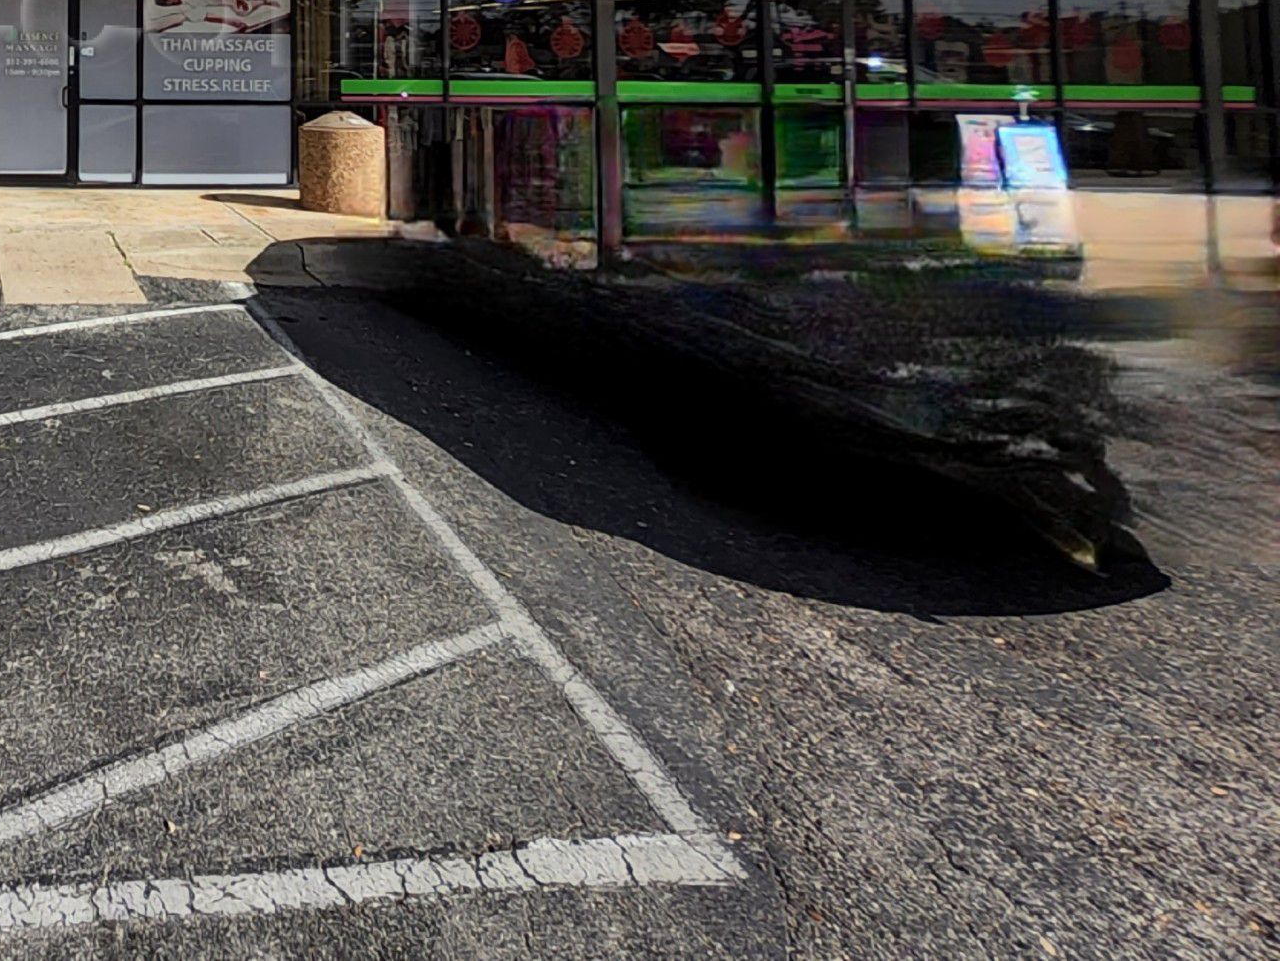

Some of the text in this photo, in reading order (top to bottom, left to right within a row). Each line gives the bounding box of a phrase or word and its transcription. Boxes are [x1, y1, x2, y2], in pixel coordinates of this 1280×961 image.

[160, 38, 275, 52] THAI MASSAGE
[183, 58, 252, 72] CUPPING
[163, 78, 272, 92] STRESS RELIEF
